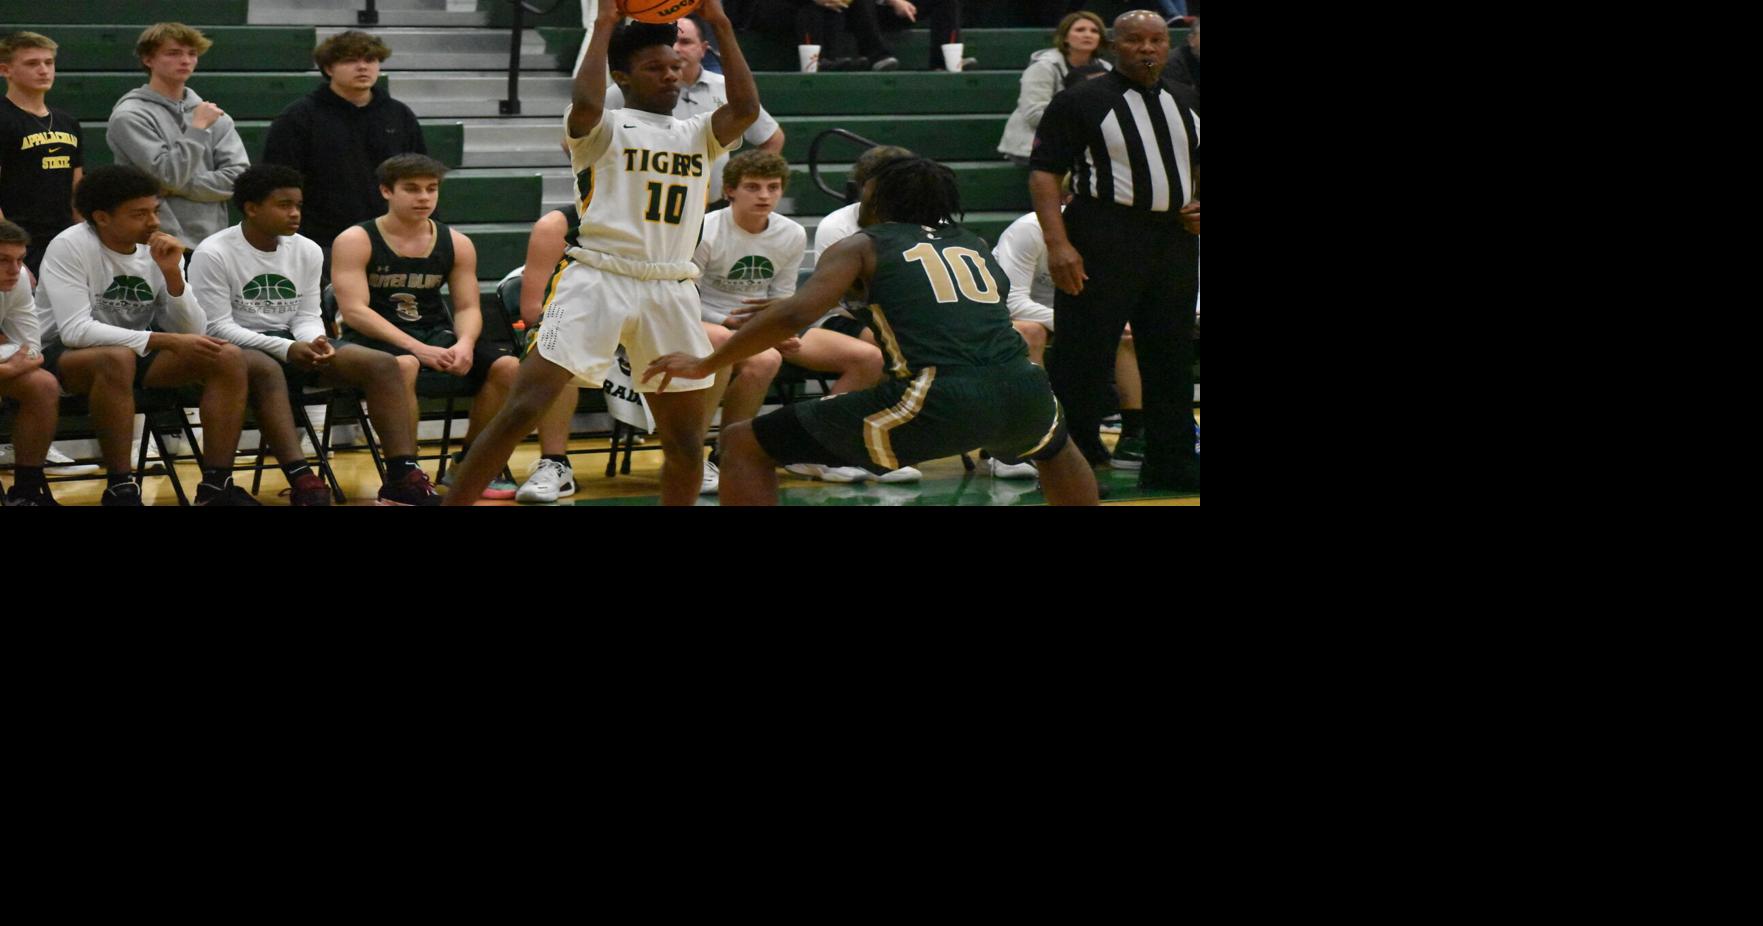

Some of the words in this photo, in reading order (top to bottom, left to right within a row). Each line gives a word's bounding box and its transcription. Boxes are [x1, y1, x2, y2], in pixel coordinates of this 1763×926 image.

[42, 156, 71, 170] STATE
[644, 181, 688, 225] 10
[903, 243, 1000, 304] 10
